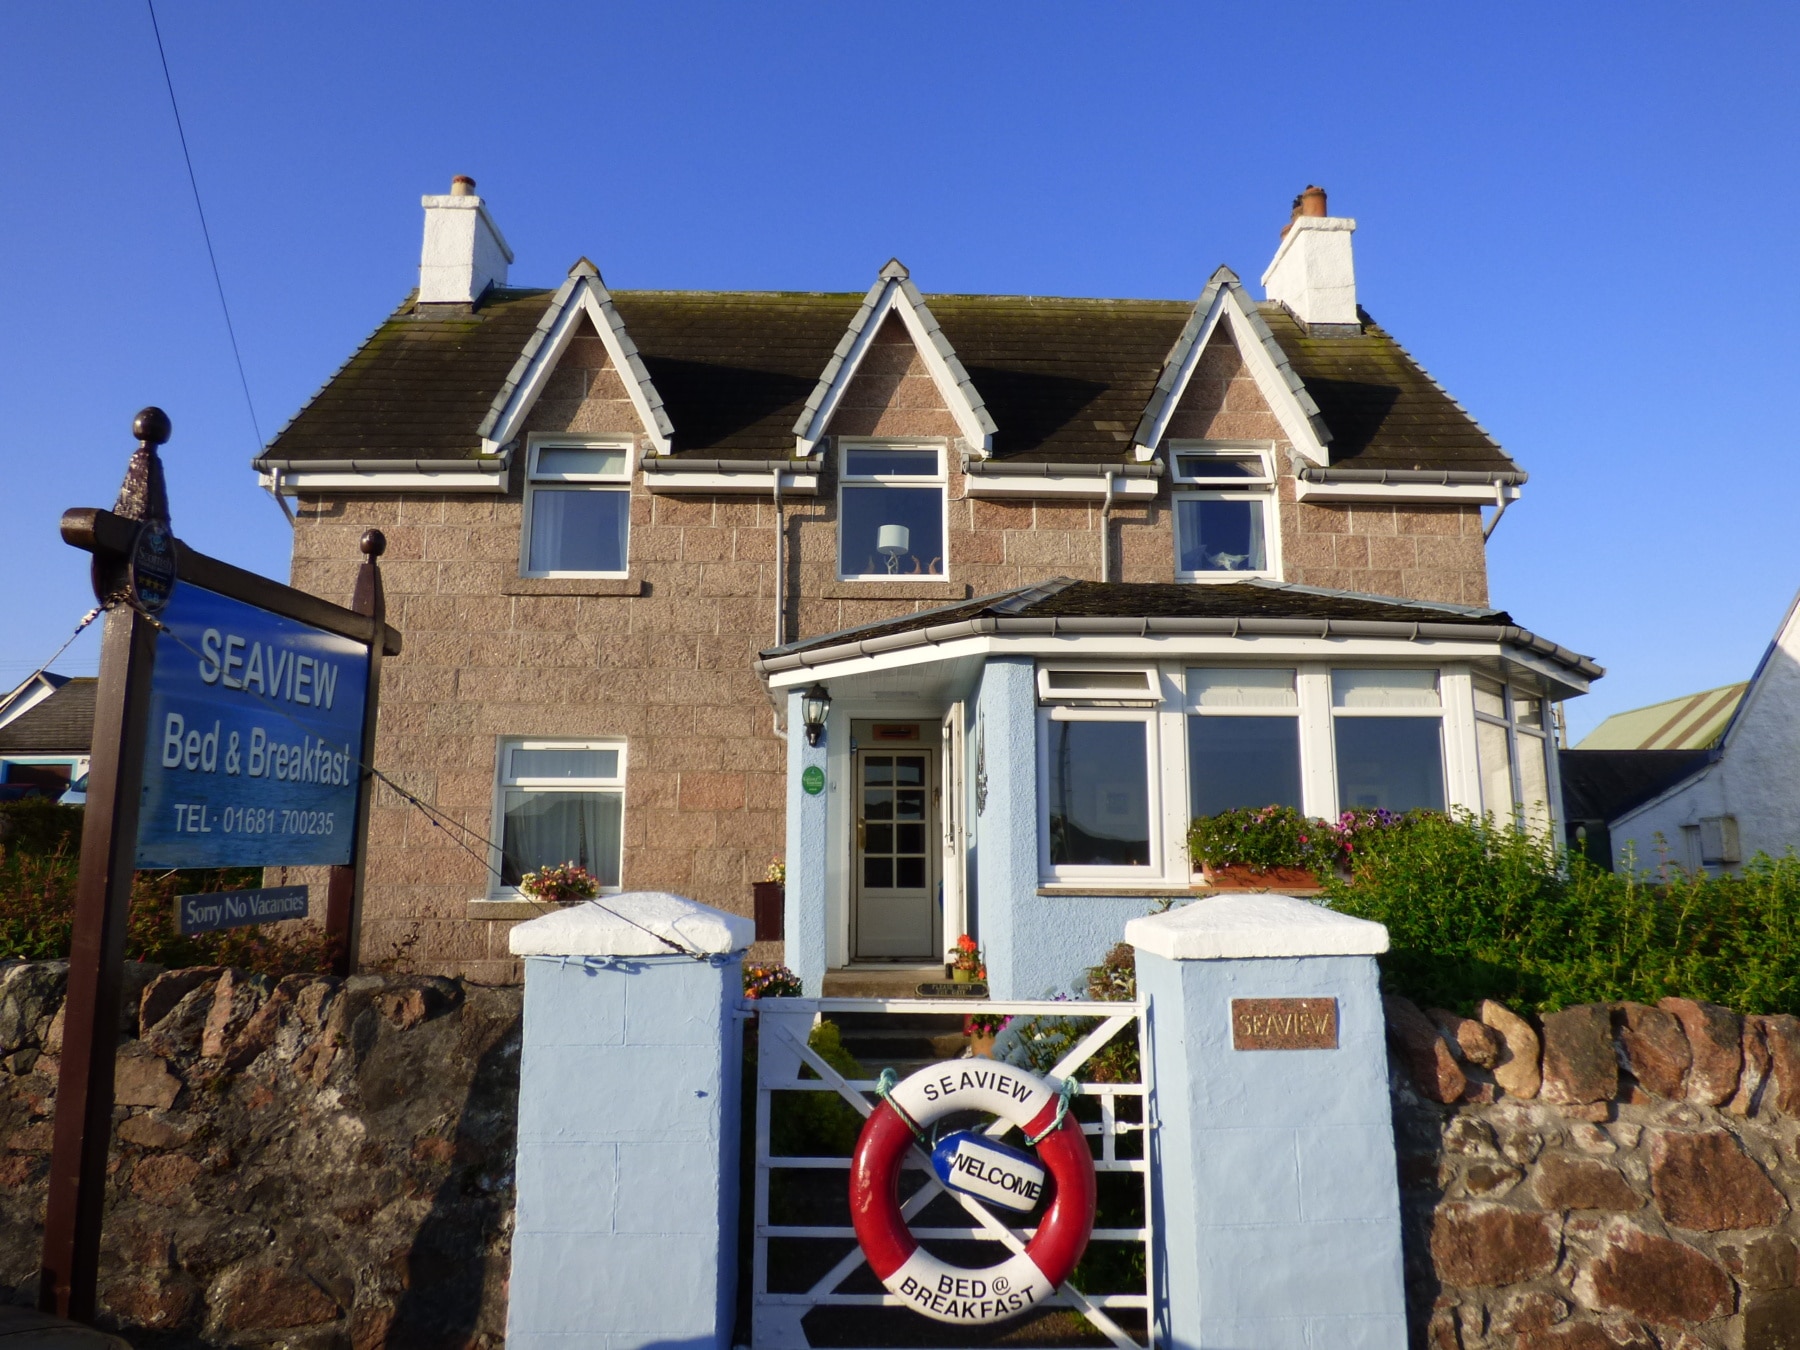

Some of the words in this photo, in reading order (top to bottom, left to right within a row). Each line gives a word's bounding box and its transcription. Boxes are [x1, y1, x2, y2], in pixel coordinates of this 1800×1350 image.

[200, 628, 338, 709] SEAVIEW
[162, 712, 220, 772] Bed
[225, 731, 241, 774] &
[248, 727, 350, 787] Breakfast
[223, 806, 275, 833] 01681
[281, 810, 334, 835] 700235
[187, 901, 223, 926] Sorry
[225, 896, 247, 919] No
[250, 892, 304, 915] Vacancies
[1240, 1013, 1329, 1036] SEAVIEW
[923, 1070, 1033, 1104] SEAVIEW
[951, 1153, 1042, 1201] WELCOME
[900, 1276, 1035, 1319] BREAKFAST
[938, 1274, 987, 1298] BED
[992, 1276, 1011, 1295] @
